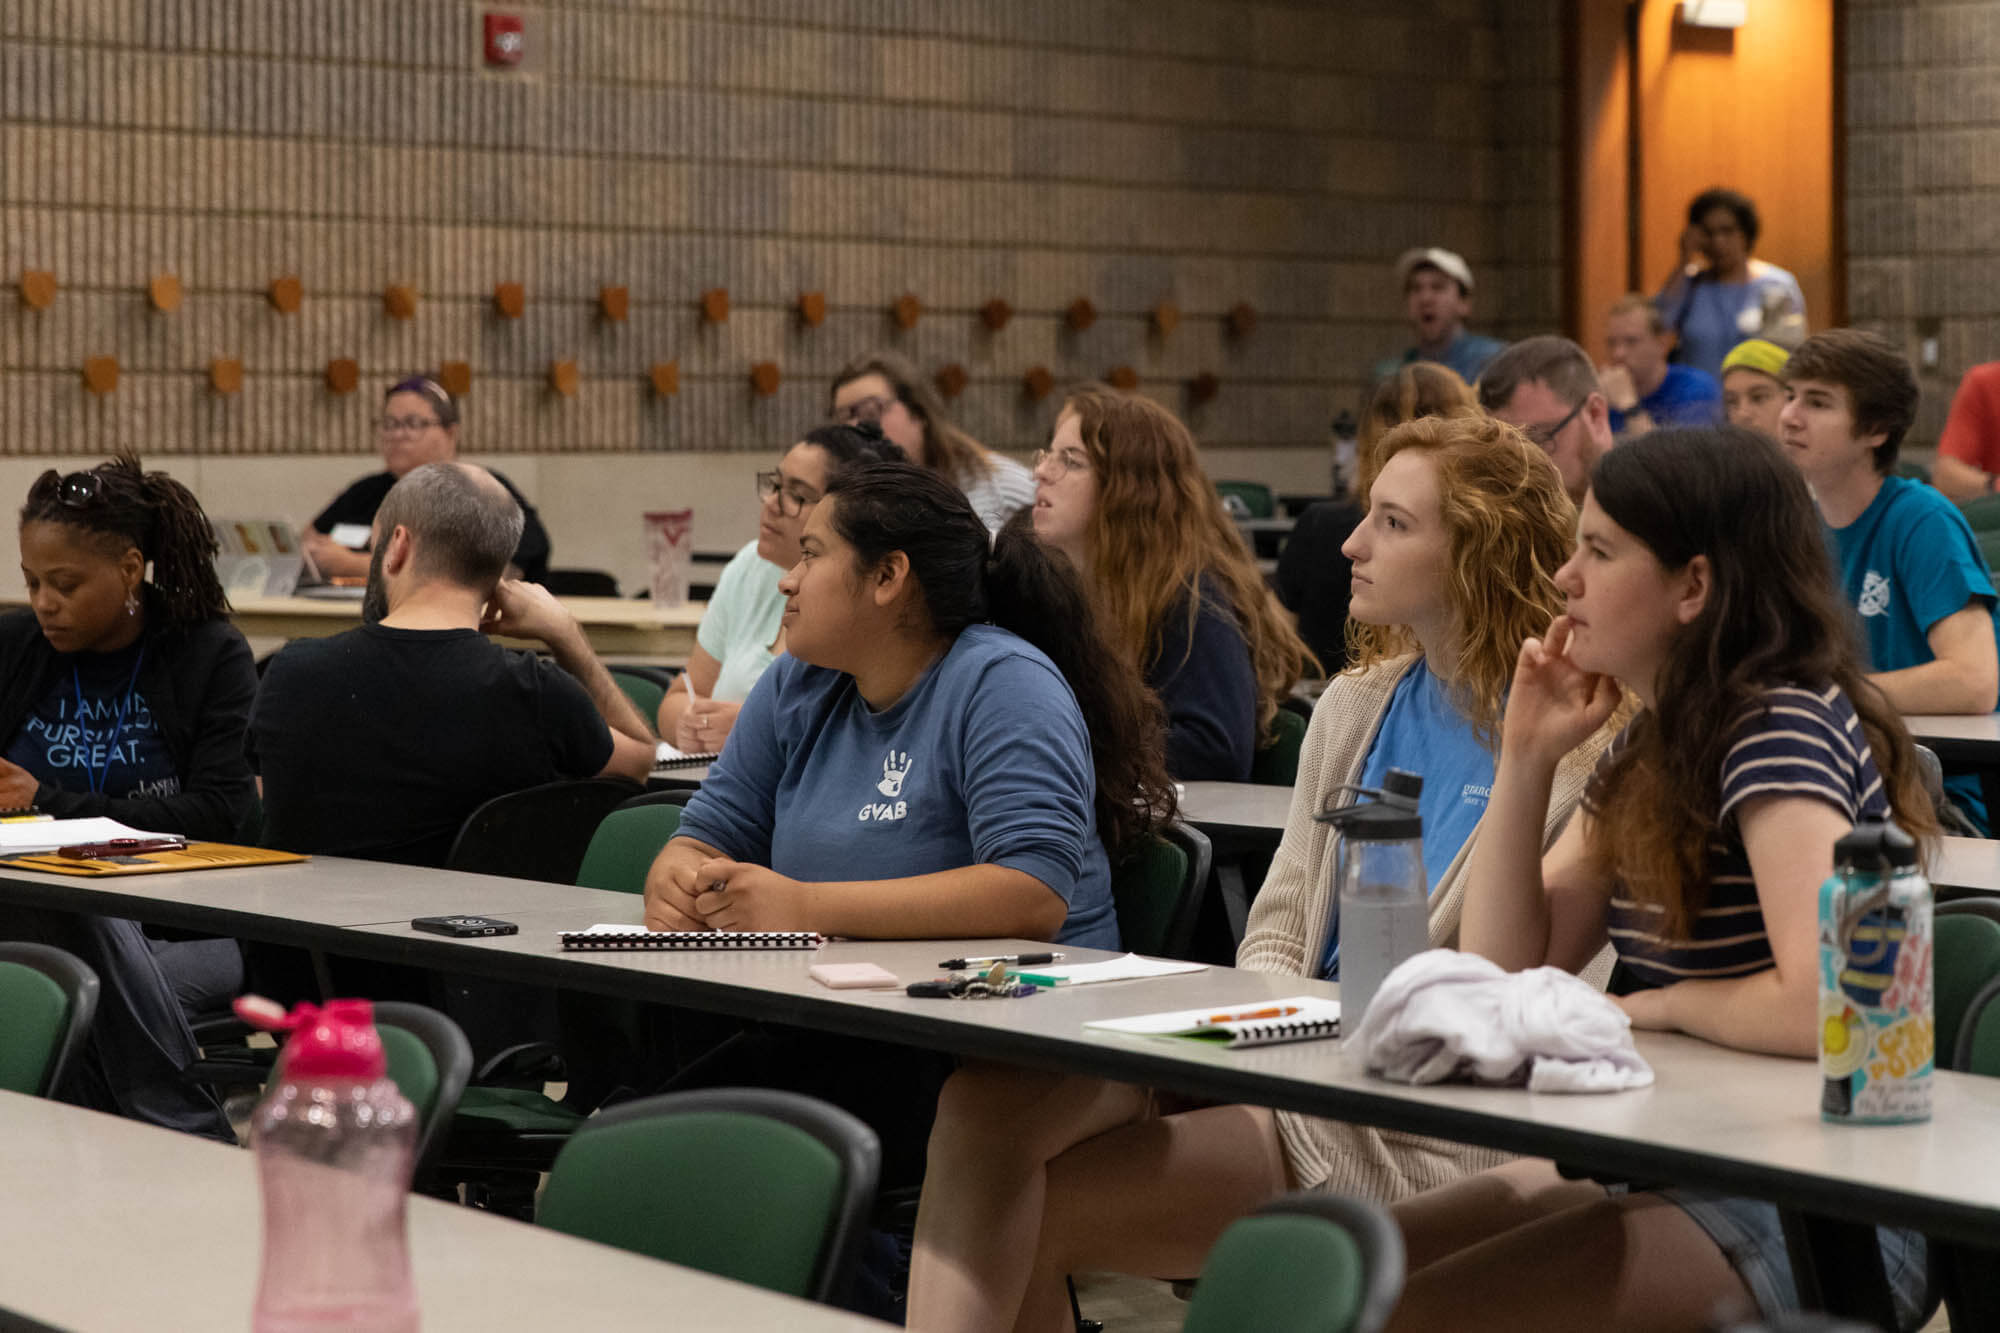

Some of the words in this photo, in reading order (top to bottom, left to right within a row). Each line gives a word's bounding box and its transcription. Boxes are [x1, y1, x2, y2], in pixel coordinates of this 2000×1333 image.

[60, 698, 66, 719] I
[73, 698, 120, 721] AM
[858, 801, 907, 821] GVAB
